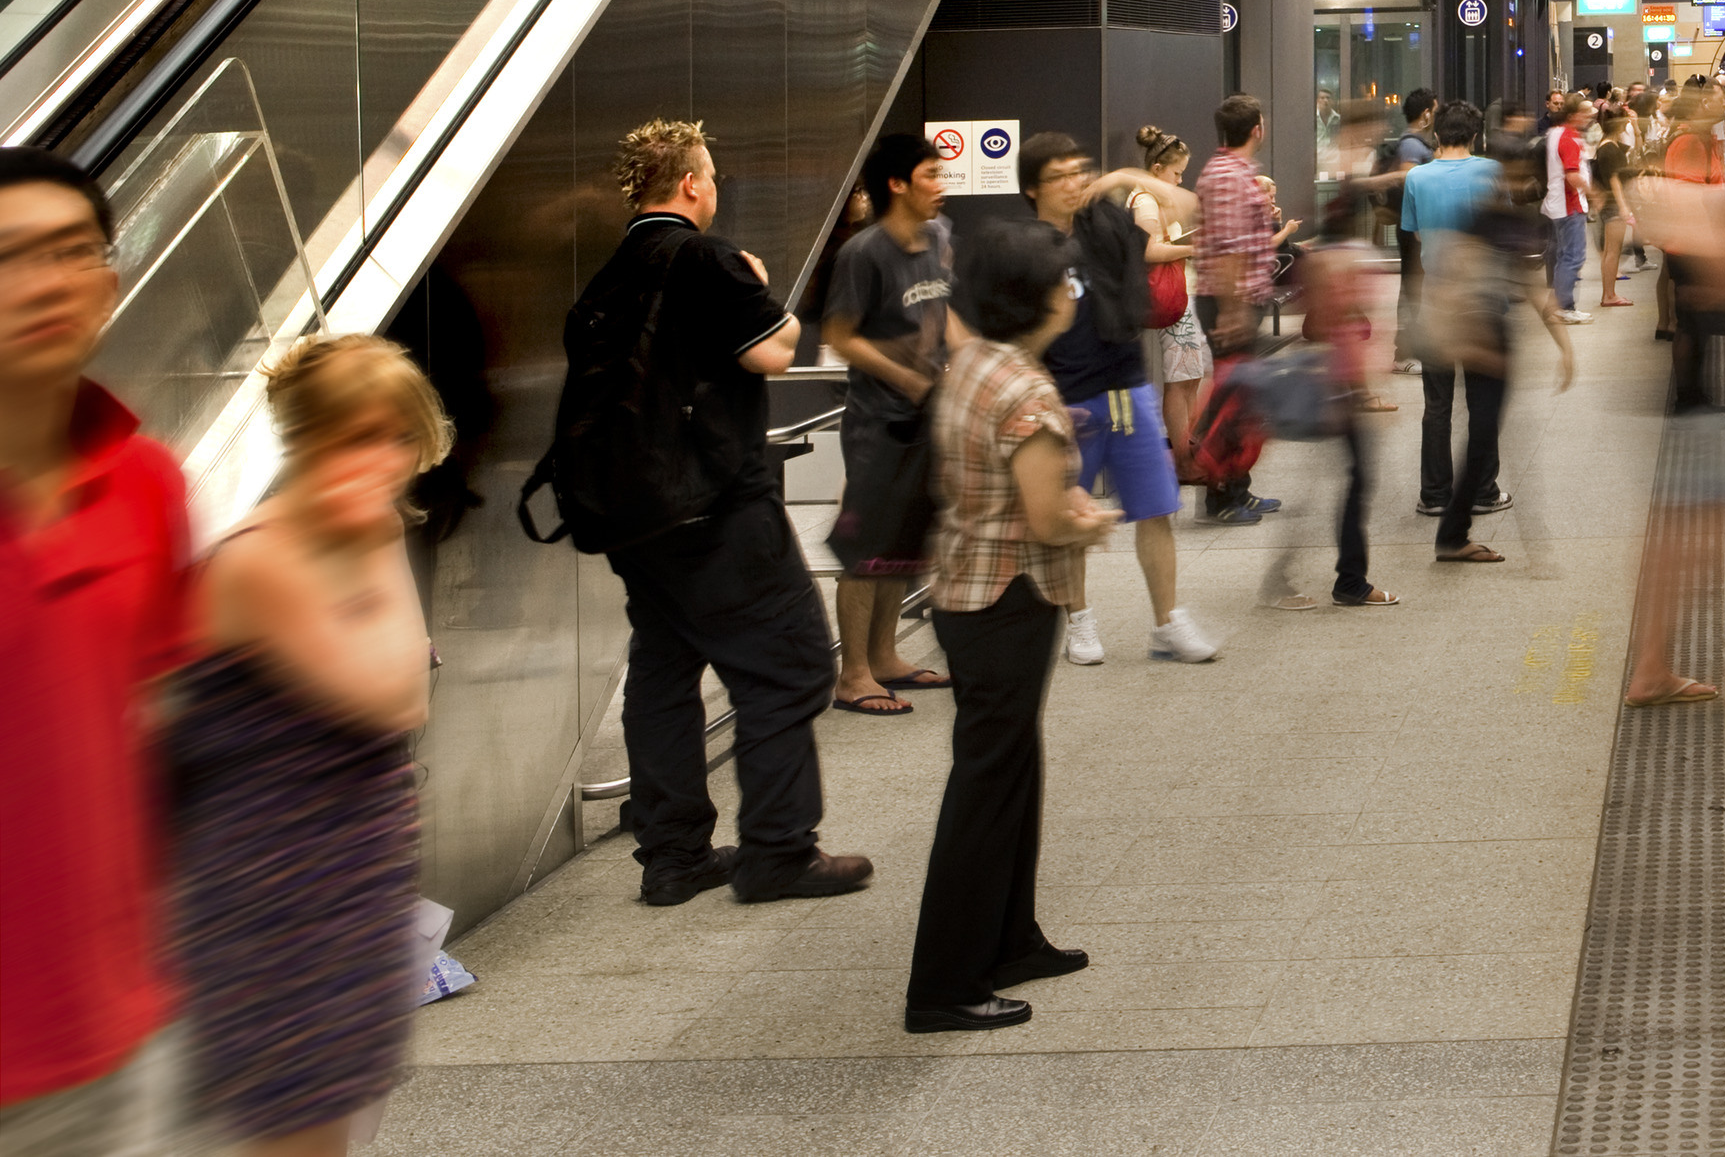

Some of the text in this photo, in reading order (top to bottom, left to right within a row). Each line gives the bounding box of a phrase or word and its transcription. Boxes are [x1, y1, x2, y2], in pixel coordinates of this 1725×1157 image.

[1591, 35, 1599, 46] 2
[1653, 51, 1660, 59] 2
[934, 171, 966, 180] moking
